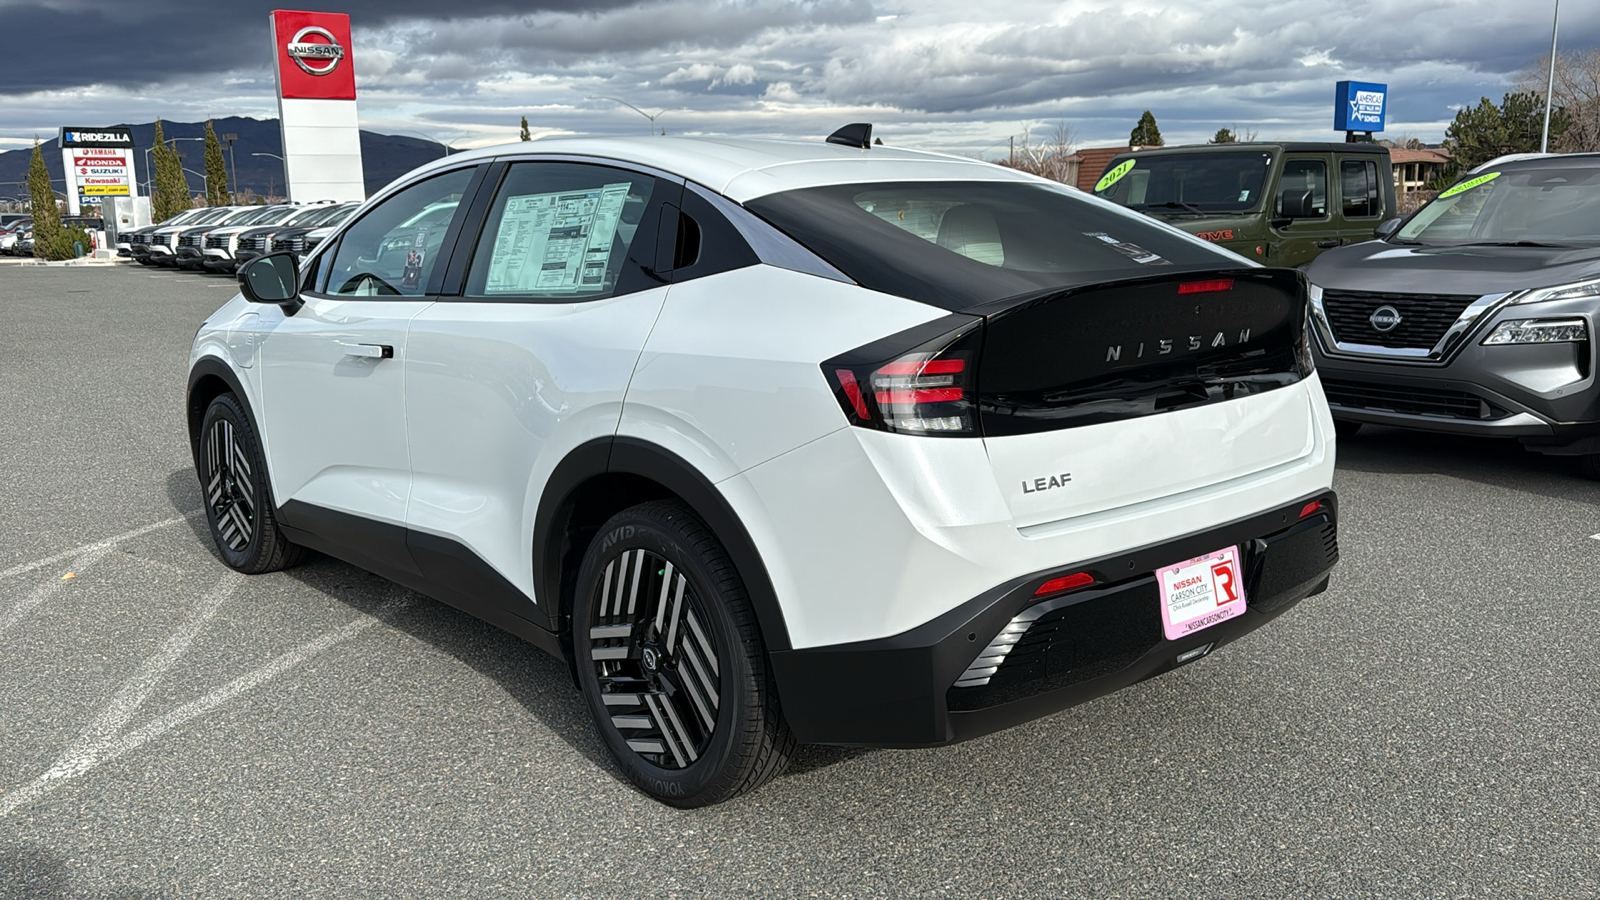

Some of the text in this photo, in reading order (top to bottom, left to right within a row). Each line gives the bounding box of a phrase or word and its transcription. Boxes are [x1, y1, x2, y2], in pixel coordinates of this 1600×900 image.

[294, 46, 339, 55] NISSAN
[81, 132, 130, 142] RIDEZILLA
[1102, 163, 1128, 188] 2021
[1106, 328, 1251, 363] NISSAN
[1022, 473, 1073, 494] LEAF
[602, 525, 635, 553] AVID
[1170, 583, 1208, 603] CARSON CITY
[1173, 575, 1203, 591] NISSAN
